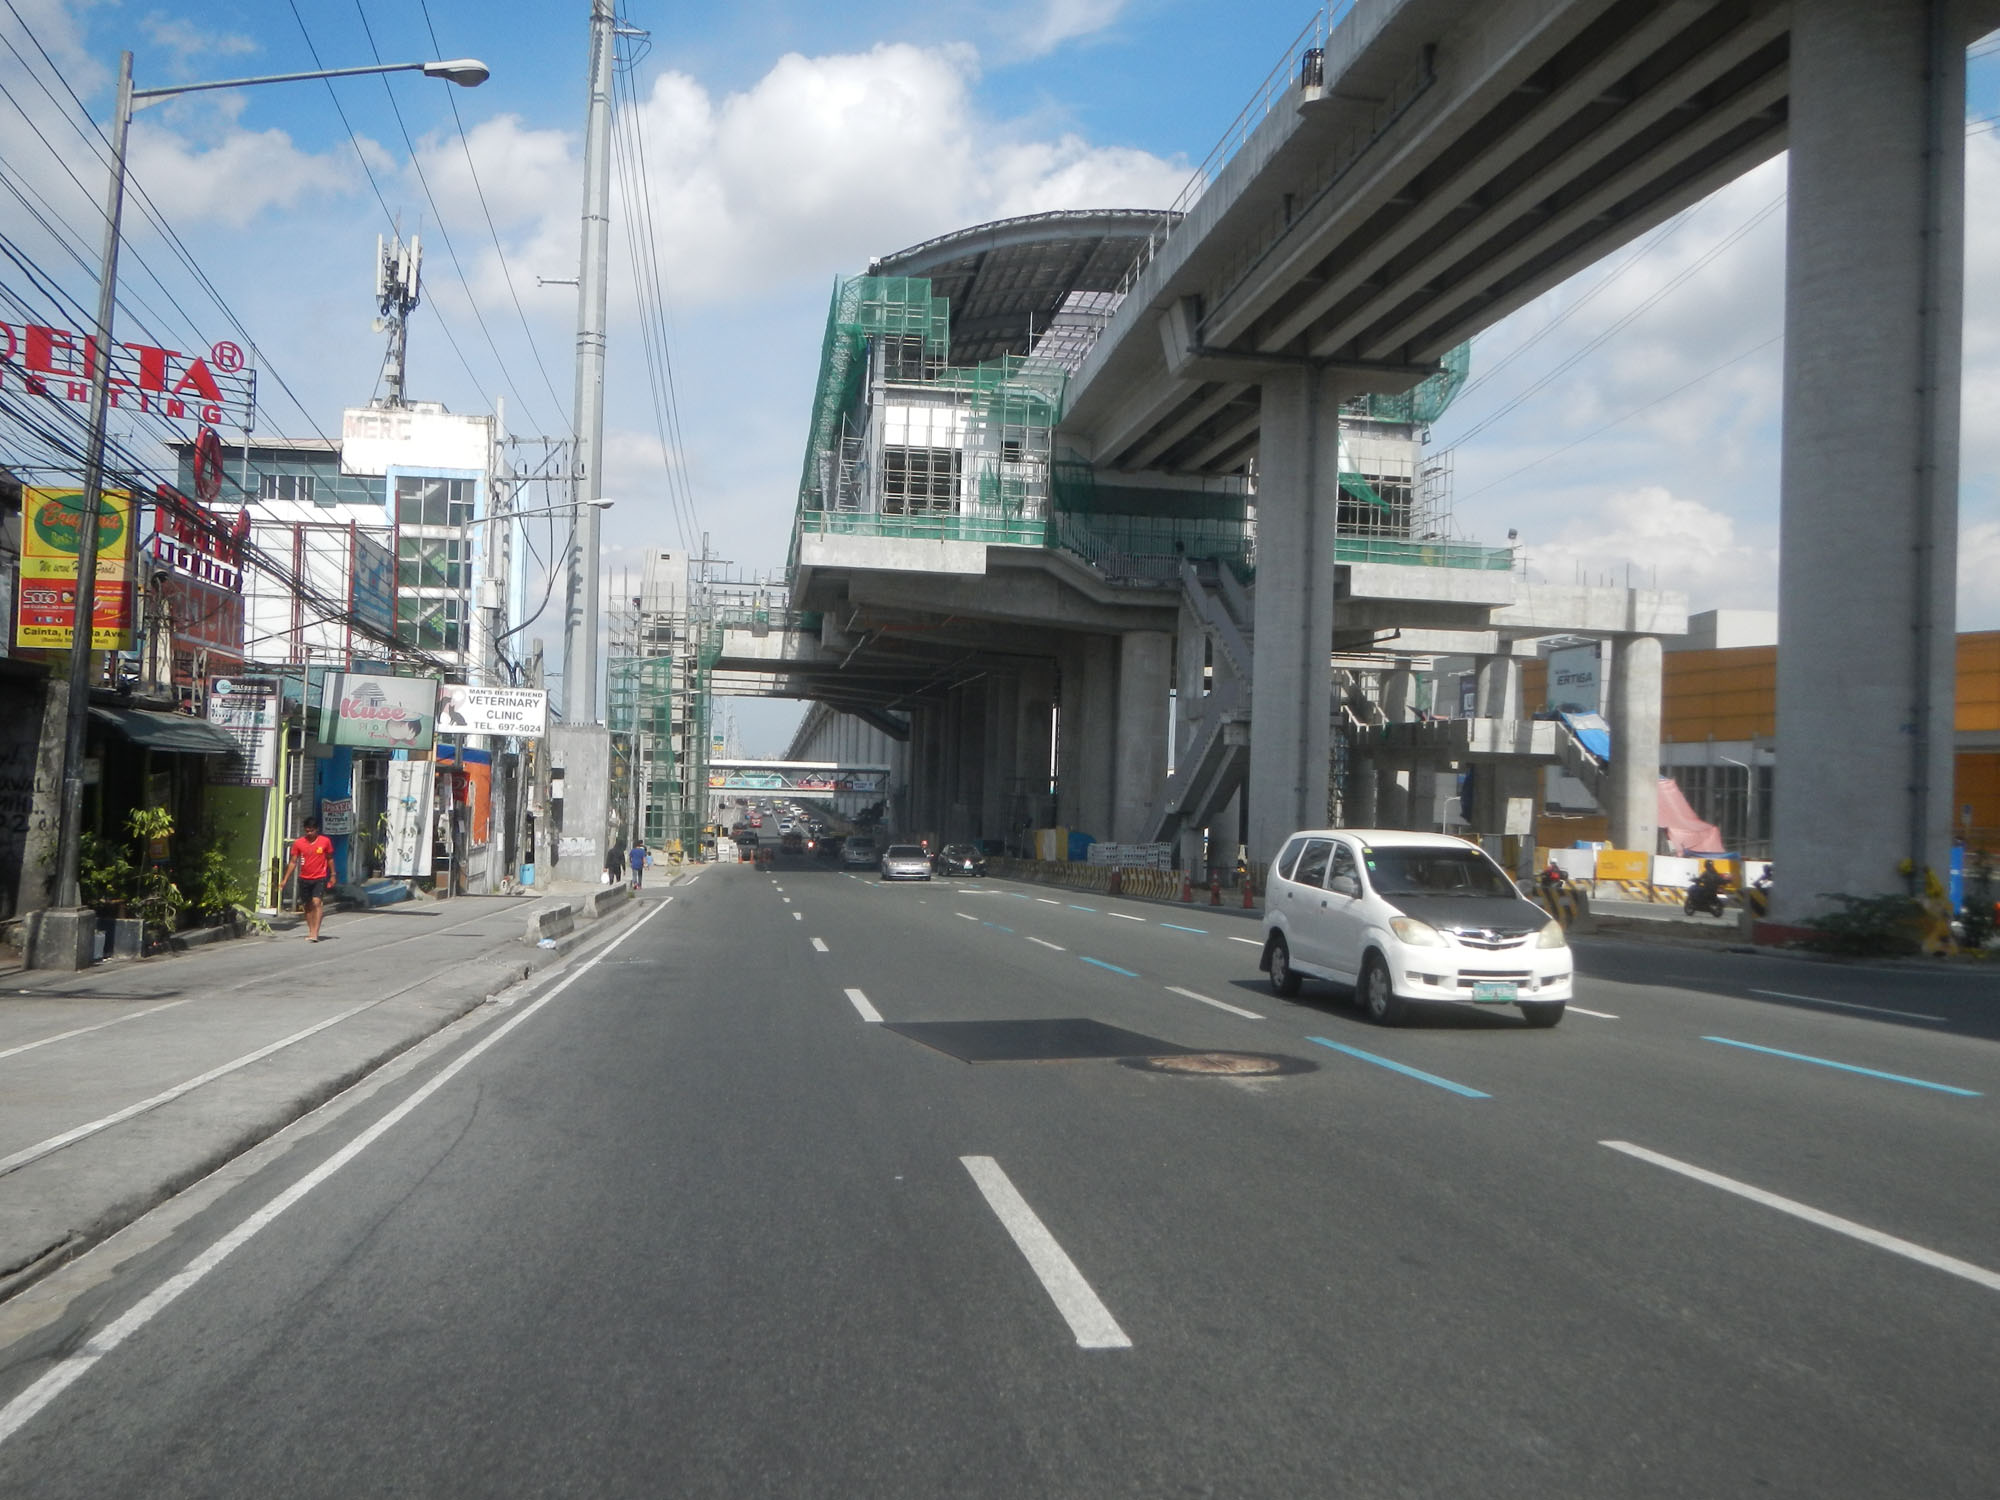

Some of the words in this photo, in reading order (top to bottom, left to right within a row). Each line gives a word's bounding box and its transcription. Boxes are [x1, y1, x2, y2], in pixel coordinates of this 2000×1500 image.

[23, 627, 62, 638] Cainta,
[1556, 672, 1593, 686] ERTIGA
[468, 696, 540, 708] VETERINARY
[486, 710, 523, 721] CLINIC
[474, 721, 496, 730] TEL.
[498, 723, 541, 732] 697-5024
